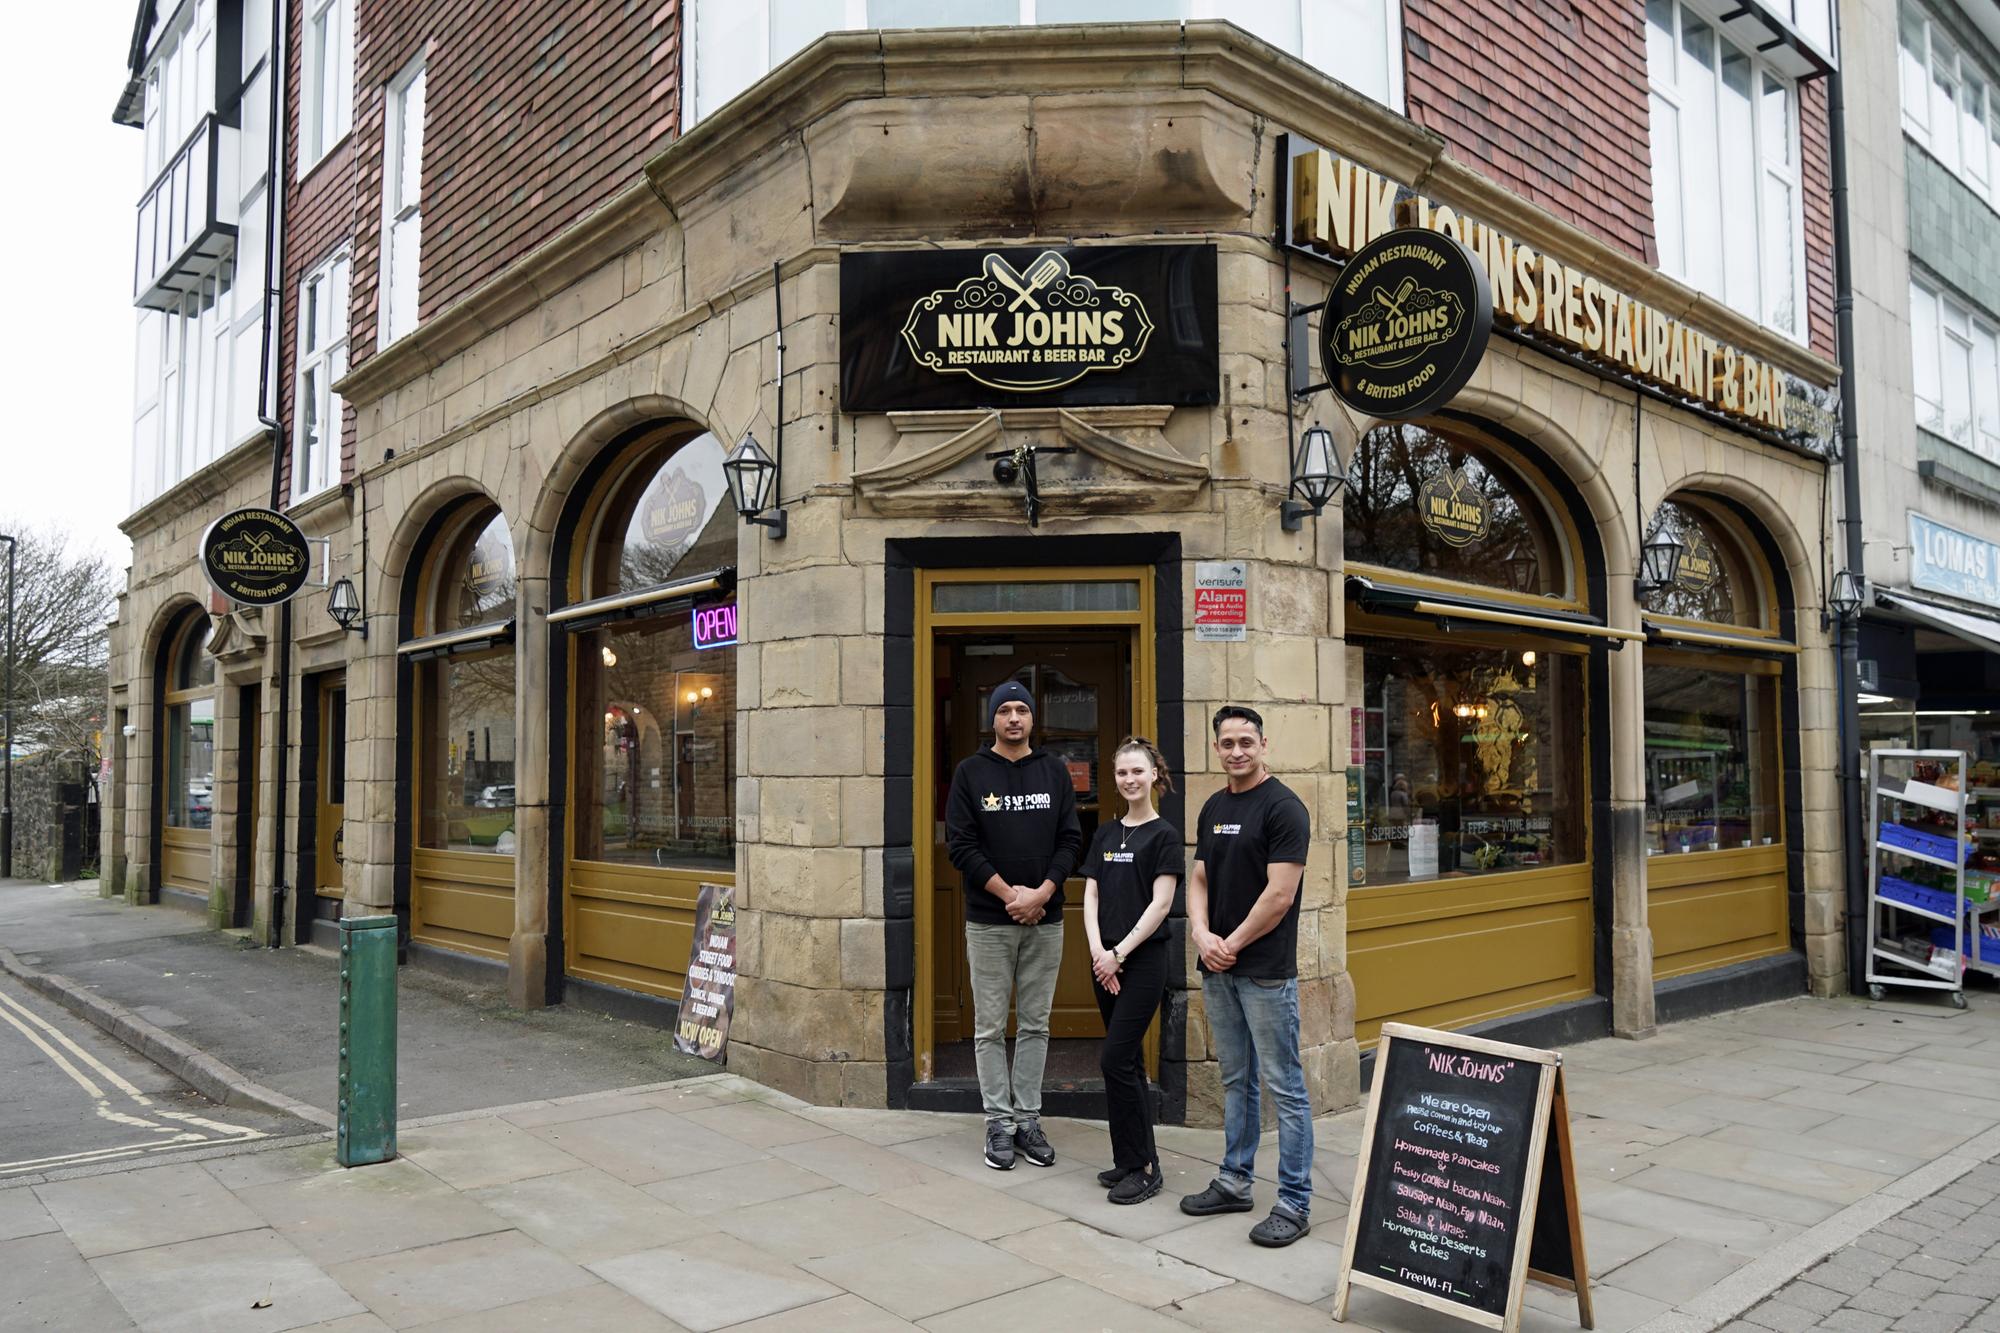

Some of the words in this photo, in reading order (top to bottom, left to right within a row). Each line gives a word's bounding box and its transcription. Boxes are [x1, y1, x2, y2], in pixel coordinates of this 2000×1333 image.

[1345, 257, 1380, 296] INDIAN
[1380, 244, 1447, 271] RESTAURANT
[938, 313, 999, 348] NIK
[1006, 310, 1125, 347] JOHNS
[1349, 323, 1381, 351] NIK
[1385, 305, 1449, 341] JOHNS
[1354, 343, 1398, 360] RESTAURANT
[1398, 341, 1404, 350] &
[1404, 334, 1423, 349] BEER
[1423, 332, 1438, 345] BAR
[1543, 254, 1718, 403] RESTAURANT
[1722, 346, 1739, 400] &
[1743, 355, 1786, 430] BAR
[949, 349, 1030, 365] RESTAURANT
[1032, 349, 1042, 363] &
[1044, 348, 1076, 363] BEER
[1078, 348, 1106, 363] BAR
[1357, 378, 1366, 391] &
[1366, 384, 1406, 399] BRITISH
[1407, 363, 1437, 393] FOOD
[220, 514, 246, 532] INDIAN
[247, 512, 293, 534] RESTAURANT
[1431, 496, 1448, 518] NIK
[1450, 502, 1481, 524] JOHNS
[223, 551, 247, 564] NIK
[250, 552, 295, 566] JOHNS
[1924, 528, 1988, 580] LOMAS
[230, 581, 238, 589] &
[237, 585, 267, 598] BRITISH
[267, 582, 287, 597] FOOD
[1199, 579, 1243, 587] verisure
[1199, 591, 1243, 603] Alarm
[697, 606, 736, 641] OPEN
[1004, 793, 1051, 807] SAPPORO
[1372, 825, 1415, 841] SPRESSO
[1502, 819, 1525, 832] WINE
[717, 952, 733, 968] FOOD
[680, 1020, 700, 1042] NOW
[699, 1025, 723, 1049] OPEN
[1406, 1105, 1430, 1118] Please
[1457, 1117, 1473, 1127] and
[1473, 1119, 1488, 1132] try
[1487, 1123, 1503, 1135] our
[1421, 1094, 1440, 1108] We
[1440, 1099, 1460, 1113] are
[1461, 1104, 1491, 1121] Open
[1413, 1120, 1454, 1141] Coffees
[1465, 1132, 1489, 1148] Teas
[1394, 1138, 1450, 1162] Homemade
[1451, 1153, 1501, 1174] Pancakes
[1437, 1160, 1447, 1173] &
[1452, 1181, 1480, 1201] bacon
[1396, 1206, 1422, 1225] Salad
[1427, 1213, 1435, 1231] &
[1461, 1206, 1475, 1222] Egg
[1382, 1218, 1439, 1243] Homemade
[1441, 1235, 1487, 1258] Desserts
[1409, 1240, 1418, 1253] &
[1419, 1243, 1450, 1261] Cakes
